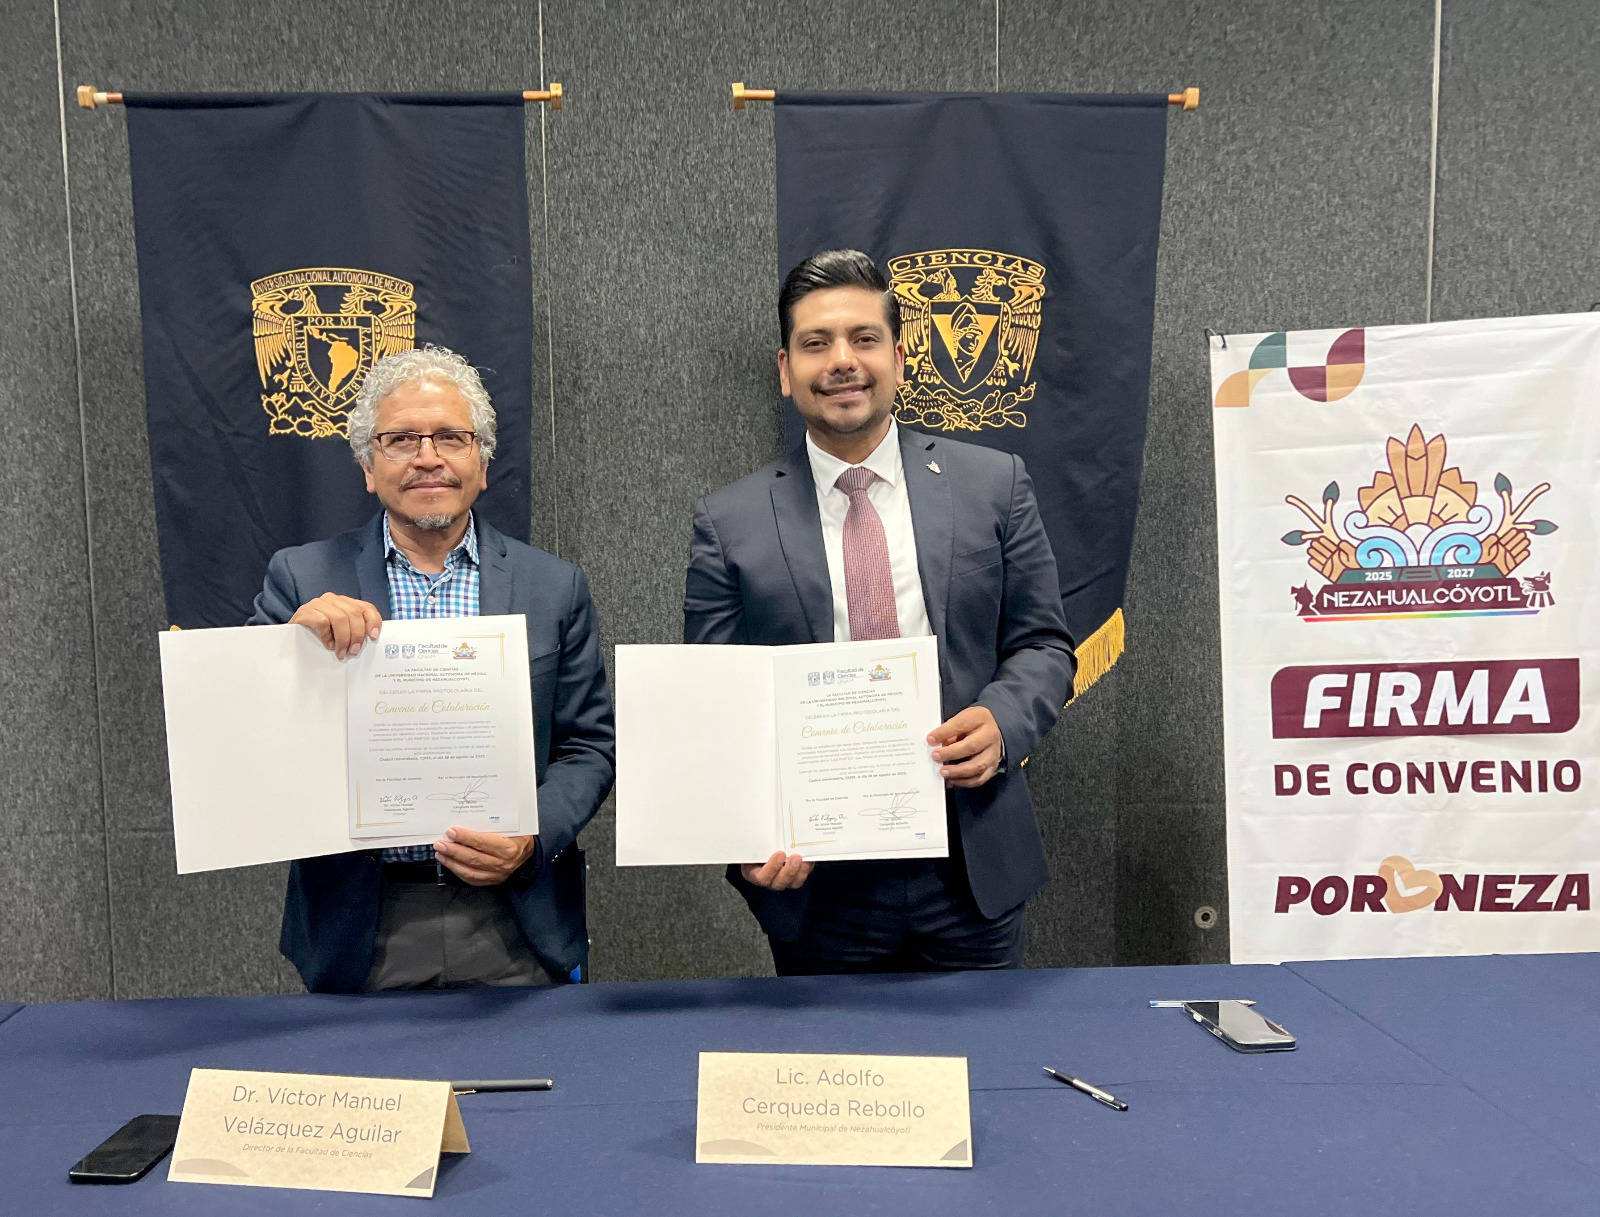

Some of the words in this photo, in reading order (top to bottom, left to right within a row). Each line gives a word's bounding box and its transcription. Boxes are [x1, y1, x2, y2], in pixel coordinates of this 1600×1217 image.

[893, 253, 1041, 277] CIENCIAS
[254, 275, 295, 295] UNIVERSIDAD
[295, 271, 331, 283] NACIONAL
[333, 271, 372, 285] AUTONOMA
[374, 278, 384, 288] DE
[384, 280, 411, 296] MEXICO
[308, 317, 335, 326] POR
[340, 317, 357, 326] MI
[362, 327, 371, 360] RAZA
[320, 365, 371, 405] HABLARA
[1365, 571, 1392, 581] 2025
[1447, 569, 1474, 578] 2027
[1323, 584, 1520, 608] NEZAHUALCÓYOTL
[375, 701, 415, 715] Convenio
[418, 702, 429, 712] de
[432, 700, 490, 713] Colaboración
[1303, 668, 1550, 728] FIRMA
[802, 726, 838, 738] Convenio
[841, 725, 851, 734] de
[853, 720, 908, 734] Colaboración
[1274, 763, 1331, 796] DE
[1346, 759, 1581, 795] CONVENIO
[1274, 875, 1388, 916] POR
[1434, 873, 1591, 912] NEZA
[776, 1068, 809, 1085] Lic.
[817, 1069, 884, 1087] Adolfo
[232, 1086, 258, 1103] Dr.
[268, 1087, 326, 1107] Víctor
[332, 1091, 402, 1111] Manuel
[742, 1098, 840, 1118] Cerqueda
[848, 1100, 925, 1118] Rebollo
[224, 1116, 324, 1139] Velázquez
[330, 1122, 402, 1144] Aguilar
[757, 1123, 797, 1132] Presidente
[800, 1124, 836, 1133] Municipal
[850, 1125, 911, 1135] Nezahualcóyotl
[243, 1143, 274, 1153] Director
[276, 1145, 285, 1153] de
[296, 1146, 328, 1156] Facultad
[330, 1148, 340, 1157] de
[342, 1149, 373, 1158] Ciencias
